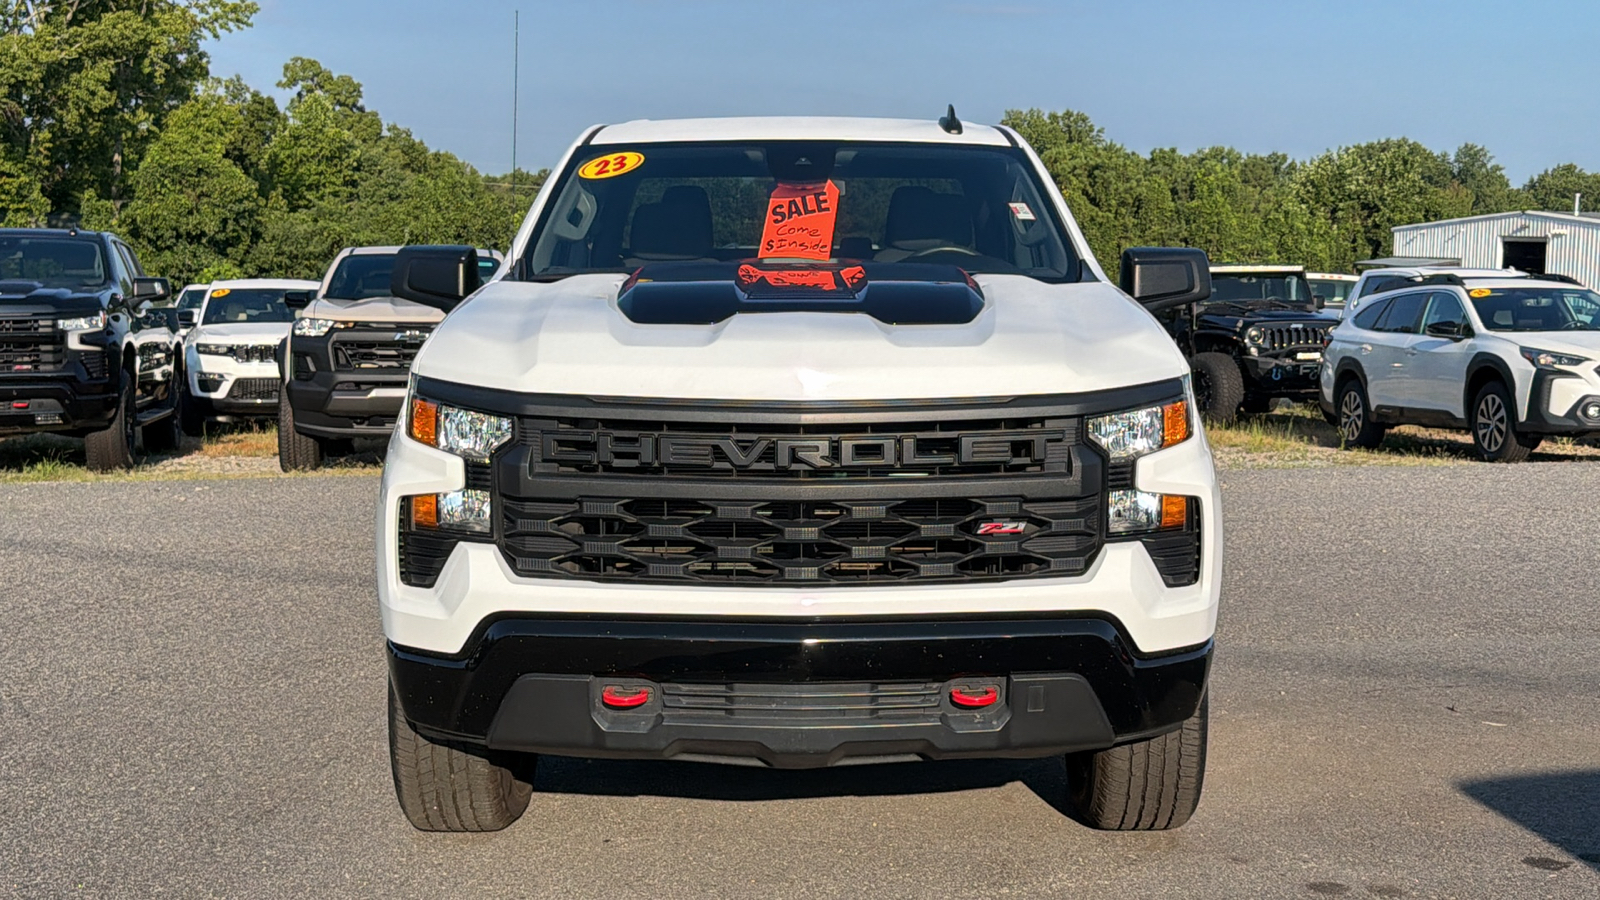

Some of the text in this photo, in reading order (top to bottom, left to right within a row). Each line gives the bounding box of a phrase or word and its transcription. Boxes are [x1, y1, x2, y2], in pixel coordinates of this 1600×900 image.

[593, 154, 628, 176] 23
[771, 191, 831, 225] SALE
[776, 224, 822, 238] Come
[539, 429, 1067, 469] CHEVROLET
